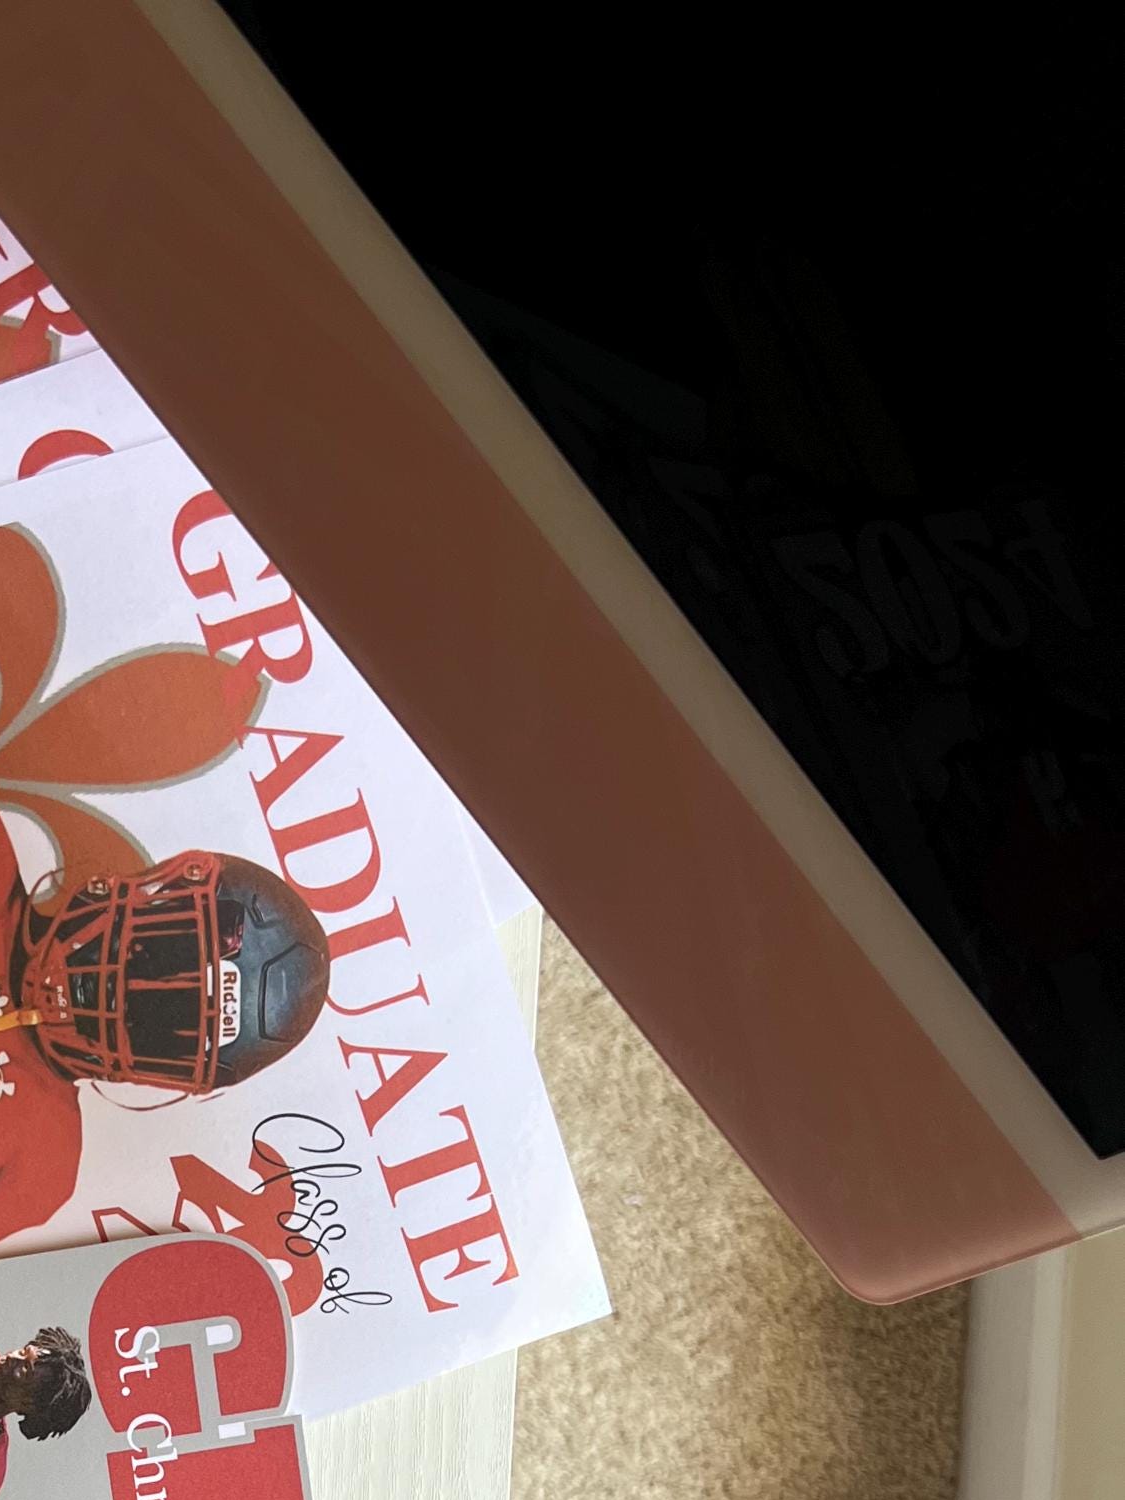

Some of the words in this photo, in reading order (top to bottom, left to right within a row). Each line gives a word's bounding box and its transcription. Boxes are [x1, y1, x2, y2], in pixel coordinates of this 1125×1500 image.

[171, 487, 519, 1314] GRADUATE
[251, 1112, 362, 1260] Class
[320, 1266, 393, 1315] of
[114, 1324, 162, 1397] St.
